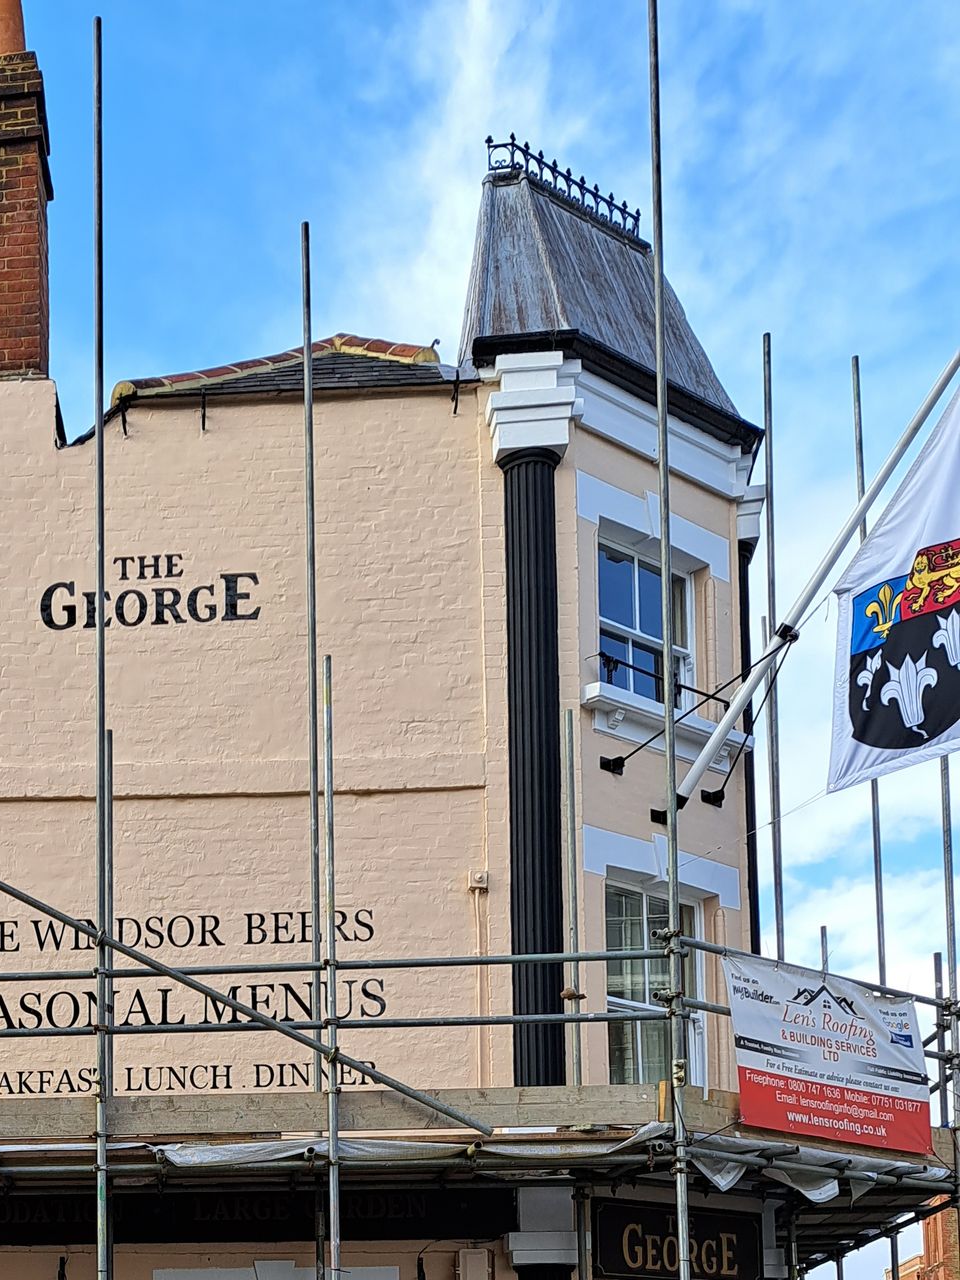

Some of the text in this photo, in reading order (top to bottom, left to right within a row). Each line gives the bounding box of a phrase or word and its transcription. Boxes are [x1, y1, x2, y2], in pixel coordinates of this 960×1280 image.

[113, 553, 184, 581] THE
[40, 571, 262, 630] GEORGE
[243, 908, 375, 945] BEERS
[198, 977, 387, 1025] MENUS
[782, 1004, 817, 1028] Len's
[822, 1013, 876, 1047] Roofing
[882, 1017, 910, 1032] Google
[781, 1029, 788, 1041] &
[789, 1031, 833, 1049] BUILDING
[834, 1040, 878, 1058] SERVICES
[822, 1050, 839, 1062] LTD
[124, 1065, 232, 1092] LUNCH
[253, 1060, 385, 1088] DINER
[766, 1059, 775, 1069] For
[781, 1062, 793, 1073] Free
[794, 1065, 818, 1078] Estimate
[826, 1072, 844, 1083] advice
[845, 1074, 862, 1086] please
[863, 1080, 882, 1090] contact
[746, 1070, 921, 1113] Freephone: 0800 747 1636 Mobile: 07751 031877
[776, 1090, 895, 1122] Email: lensroofinginfo@gmail.com
[787, 1111, 887, 1137] www.lensroofing.co.uk
[192, 1193, 427, 1222] LARGE GRDEN
[666, 1214, 696, 1235] TE
[622, 1223, 739, 1277] GEORGE
